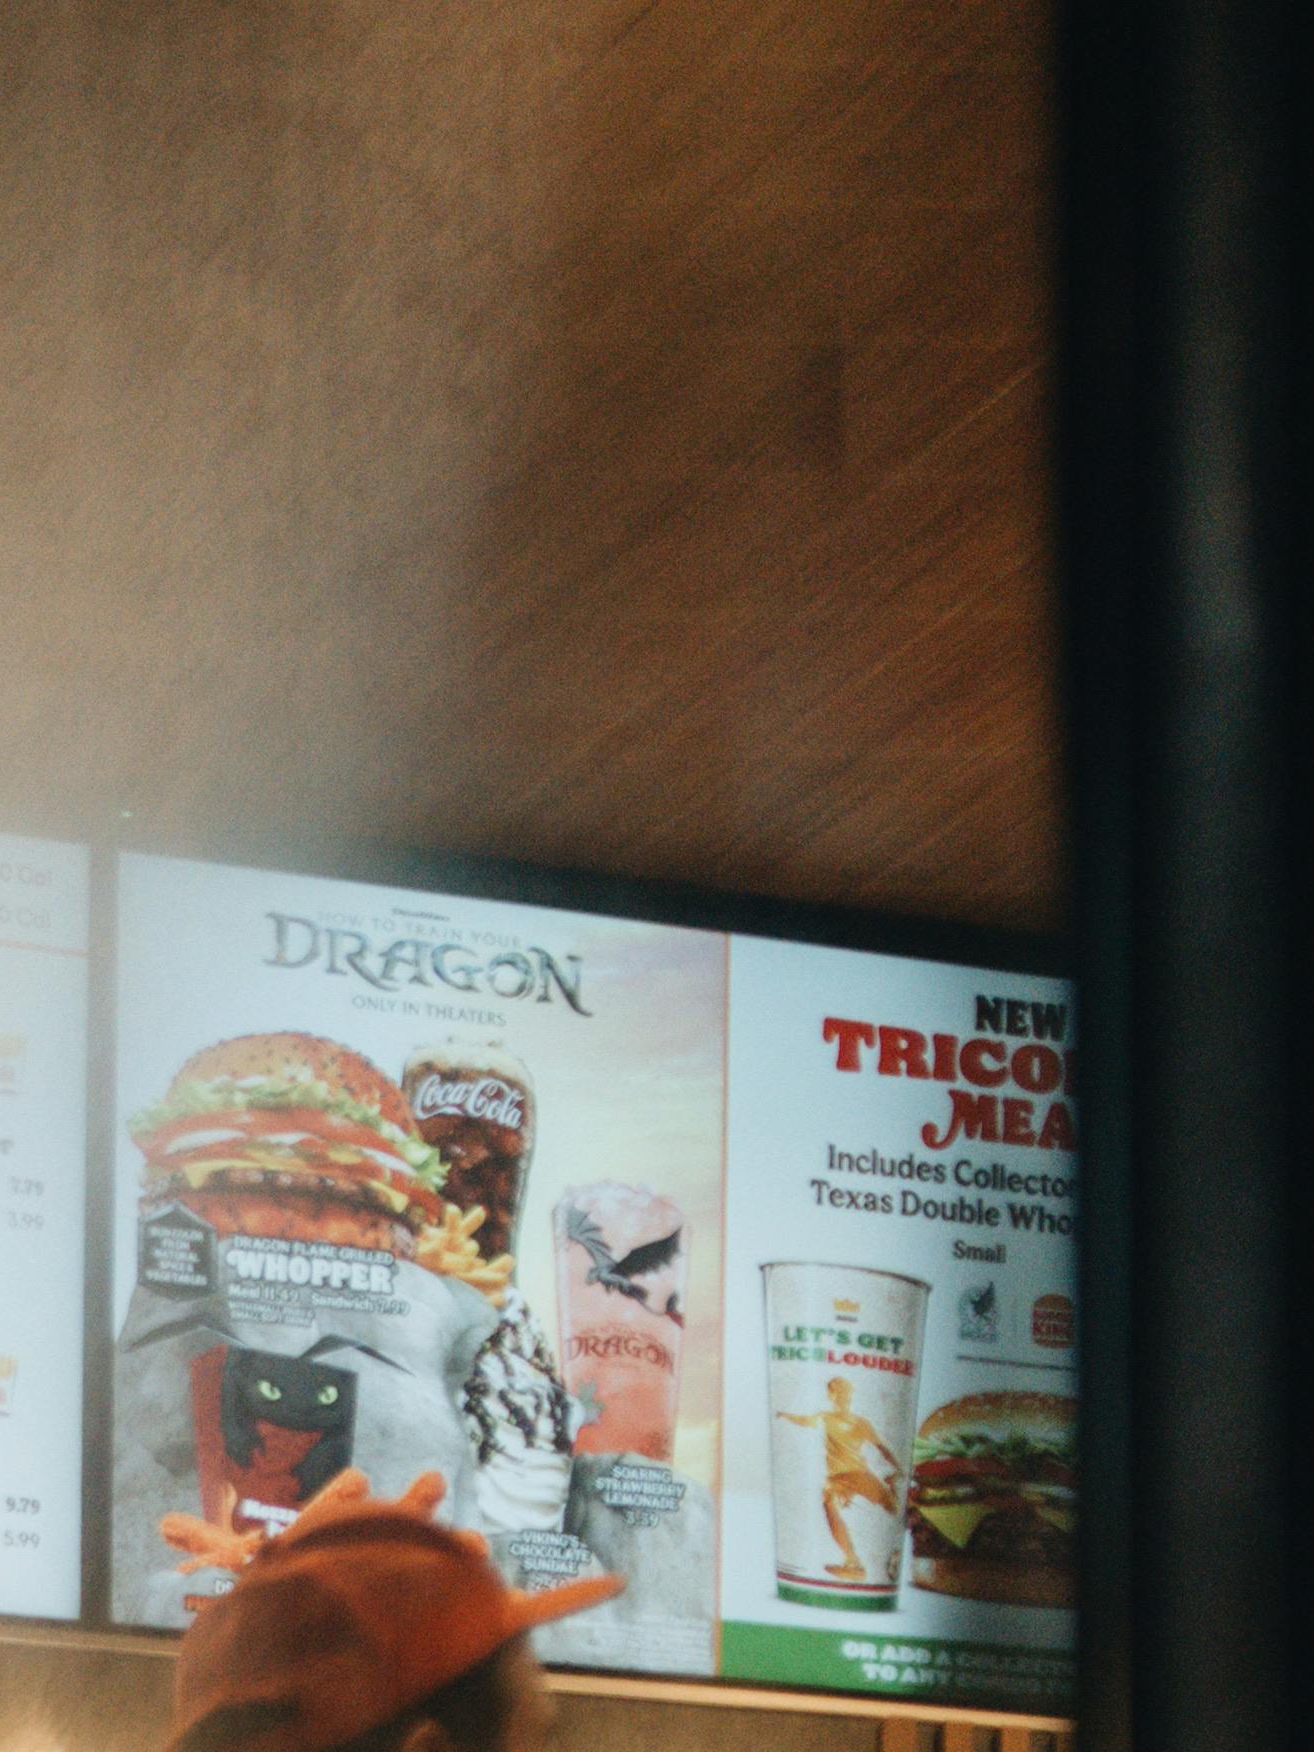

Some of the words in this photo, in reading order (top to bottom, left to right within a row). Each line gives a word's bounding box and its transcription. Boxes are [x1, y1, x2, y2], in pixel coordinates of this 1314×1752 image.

[372, 916, 397, 934] TO
[404, 920, 463, 943] TRAIN
[469, 931, 523, 948] YOUR
[262, 911, 594, 1019] DRAGON
[351, 995, 398, 1014] ONLY
[402, 1001, 420, 1017] IN
[424, 1004, 508, 1029] THEATERS
[974, 994, 1069, 1043] NEW
[412, 1072, 524, 1130] Coca-Cola
[827, 1144, 946, 1184] Includes
[810, 1178, 894, 1216] Texas
[901, 1190, 1000, 1231] Double
[952, 1239, 1007, 1264] Small
[226, 1250, 394, 1295] WHOPPER
[228, 1284, 261, 1299] Meal
[311, 1292, 375, 1312] Sandwich
[784, 1323, 852, 1346] LET'S
[857, 1332, 904, 1355] GET
[611, 1465, 672, 1483] SOARING
[595, 1477, 685, 1498] STRAWBERRY
[5, 1494, 41, 1516] 9.79
[604, 1494, 678, 1512] LEMONADE
[2, 1530, 41, 1549] 5.99
[510, 1544, 591, 1564] CHOCOLATE
[523, 1558, 578, 1575] SUNDAE
[841, 1640, 877, 1660] OR
[880, 1644, 931, 1664] ADD
[862, 1662, 898, 1682] TO
